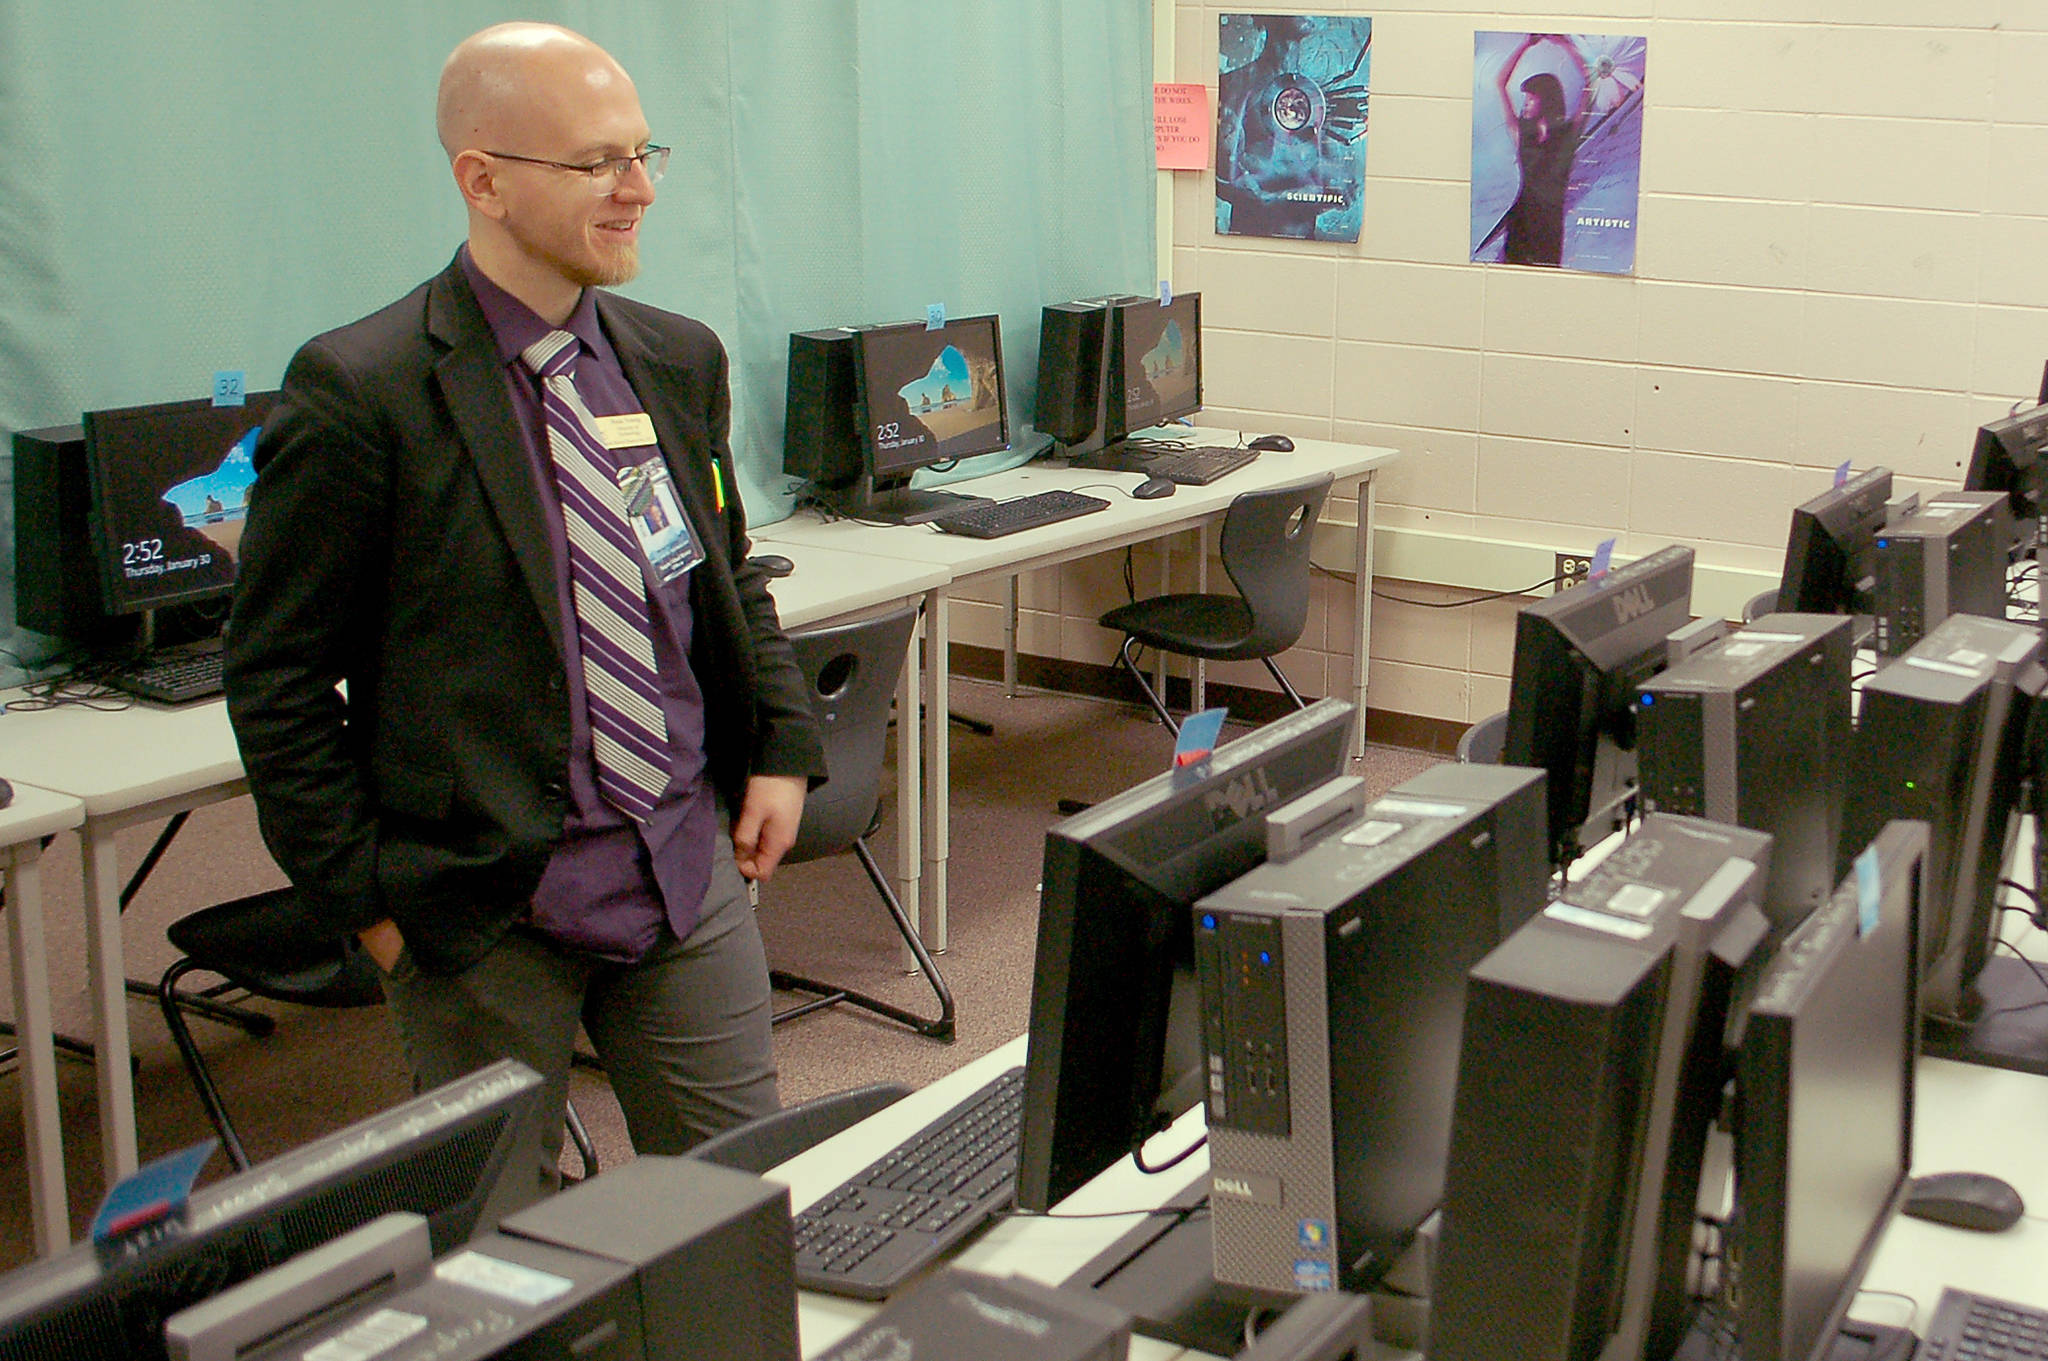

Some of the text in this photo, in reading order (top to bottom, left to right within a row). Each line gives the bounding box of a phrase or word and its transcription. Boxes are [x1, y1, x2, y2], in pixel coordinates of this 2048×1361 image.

[1172, 87, 1187, 95] NOT
[1286, 192, 1345, 204] SCIENTIFIC
[1576, 217, 1631, 229] ARTISTIC
[219, 378, 239, 396] 32
[876, 421, 900, 440] 2:52
[122, 538, 164, 565] 2:52
[167, 558, 199, 572] January
[199, 553, 212, 565] 30
[1213, 1177, 1252, 1197] DELL
